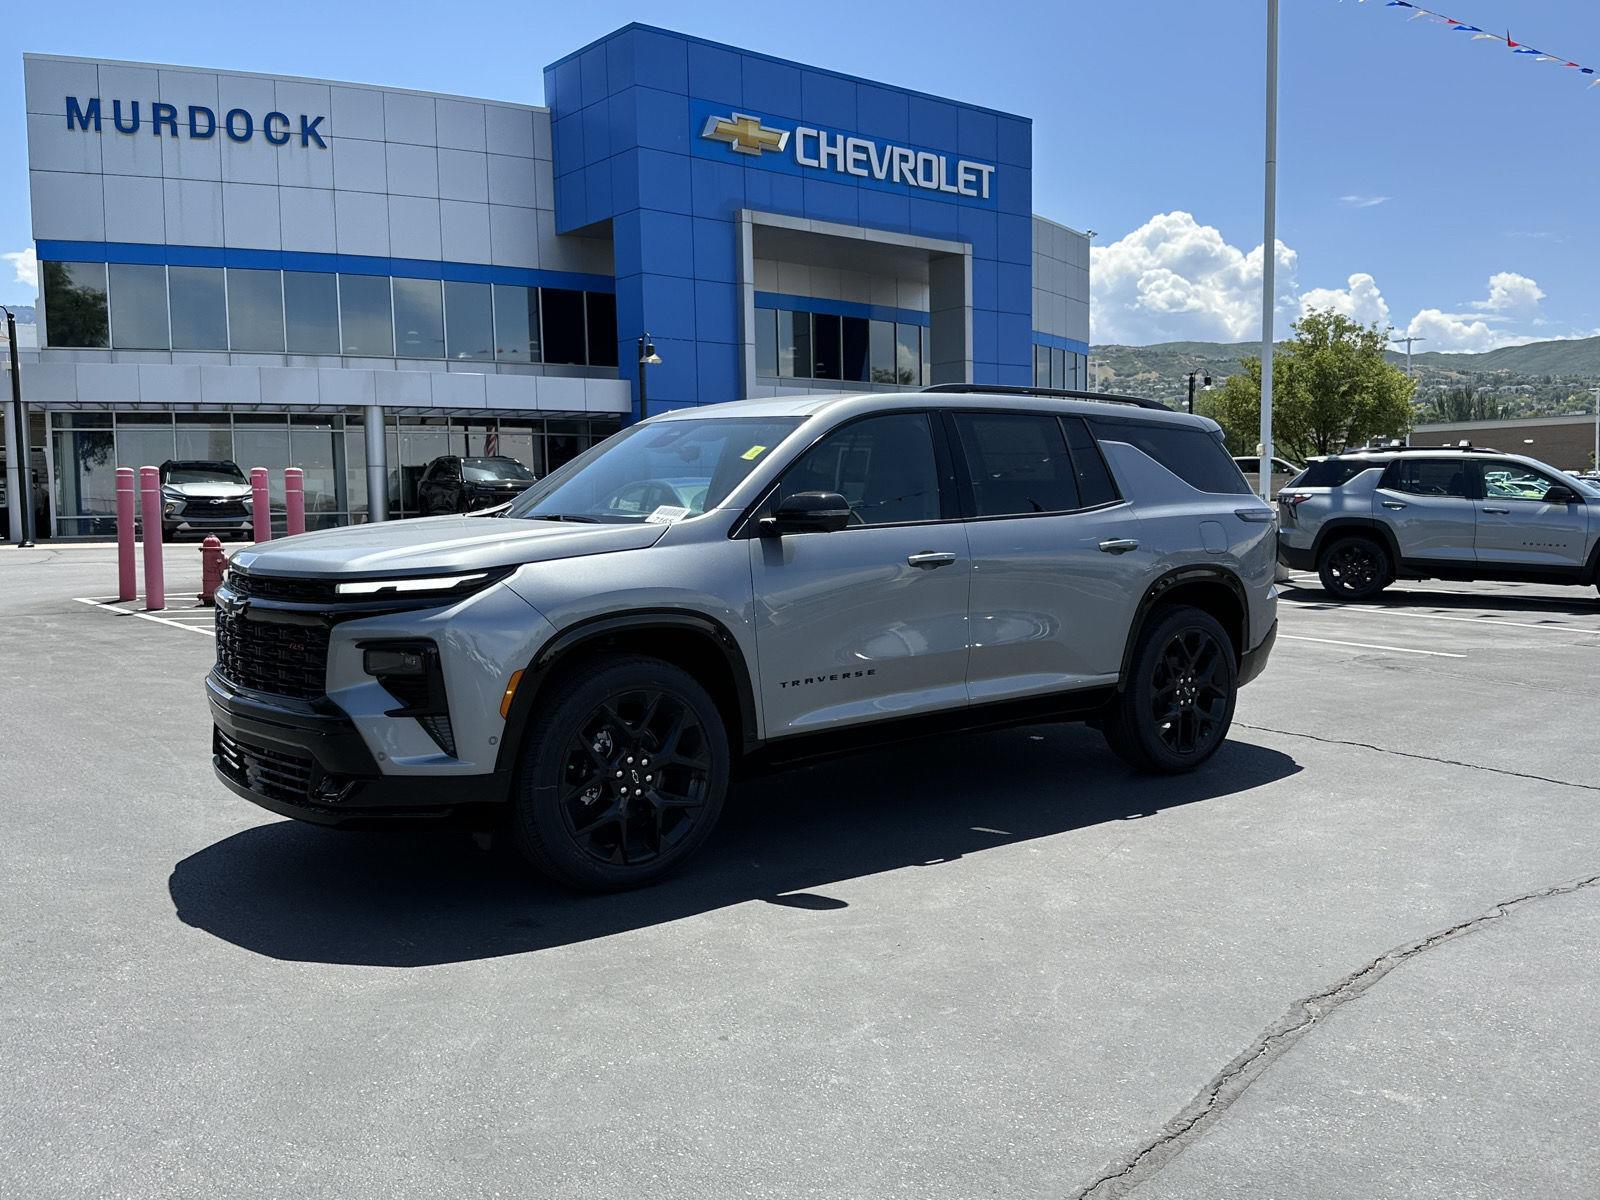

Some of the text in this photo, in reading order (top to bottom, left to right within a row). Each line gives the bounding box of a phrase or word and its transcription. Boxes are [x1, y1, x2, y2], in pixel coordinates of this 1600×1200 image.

[65, 95, 327, 150] MURDOCK
[795, 126, 996, 199] CHEVROLET
[780, 669, 876, 688] TRAVERSE
